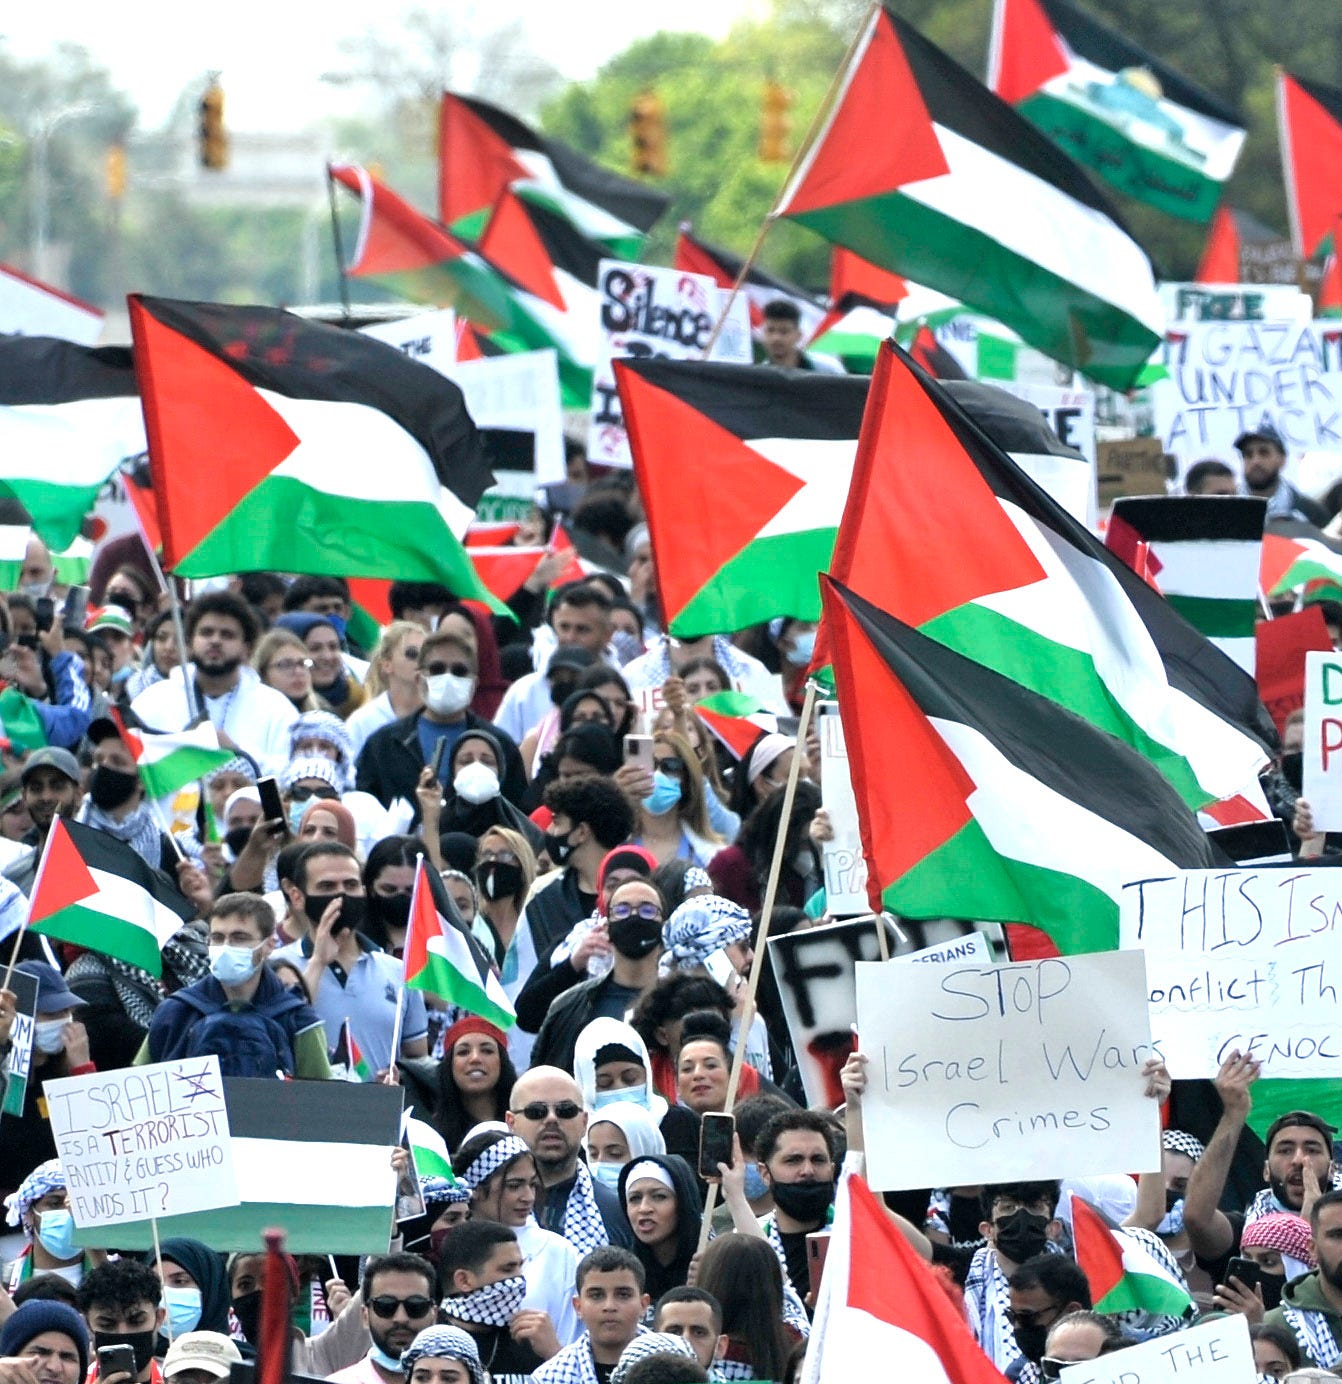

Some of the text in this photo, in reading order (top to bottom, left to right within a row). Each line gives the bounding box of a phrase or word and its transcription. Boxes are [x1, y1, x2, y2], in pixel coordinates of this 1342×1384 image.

[605, 268, 714, 350] Silence
[1200, 324, 1322, 366] GAZA
[1176, 366, 1337, 405] UNDER
[1122, 873, 1263, 951] THIS
[930, 957, 1073, 1021] STOP
[1148, 976, 1265, 1005] onflict
[881, 1036, 1009, 1093] Israel
[63, 1108, 226, 1158] IS A TERRORIST
[945, 1102, 1112, 1150] Crimes
[66, 1160, 119, 1190] ENTITY
[136, 1151, 184, 1182] GUESS
[187, 1144, 224, 1178] WHO
[76, 1192, 124, 1222] FUNDS
[1161, 1338, 1230, 1374] THE
